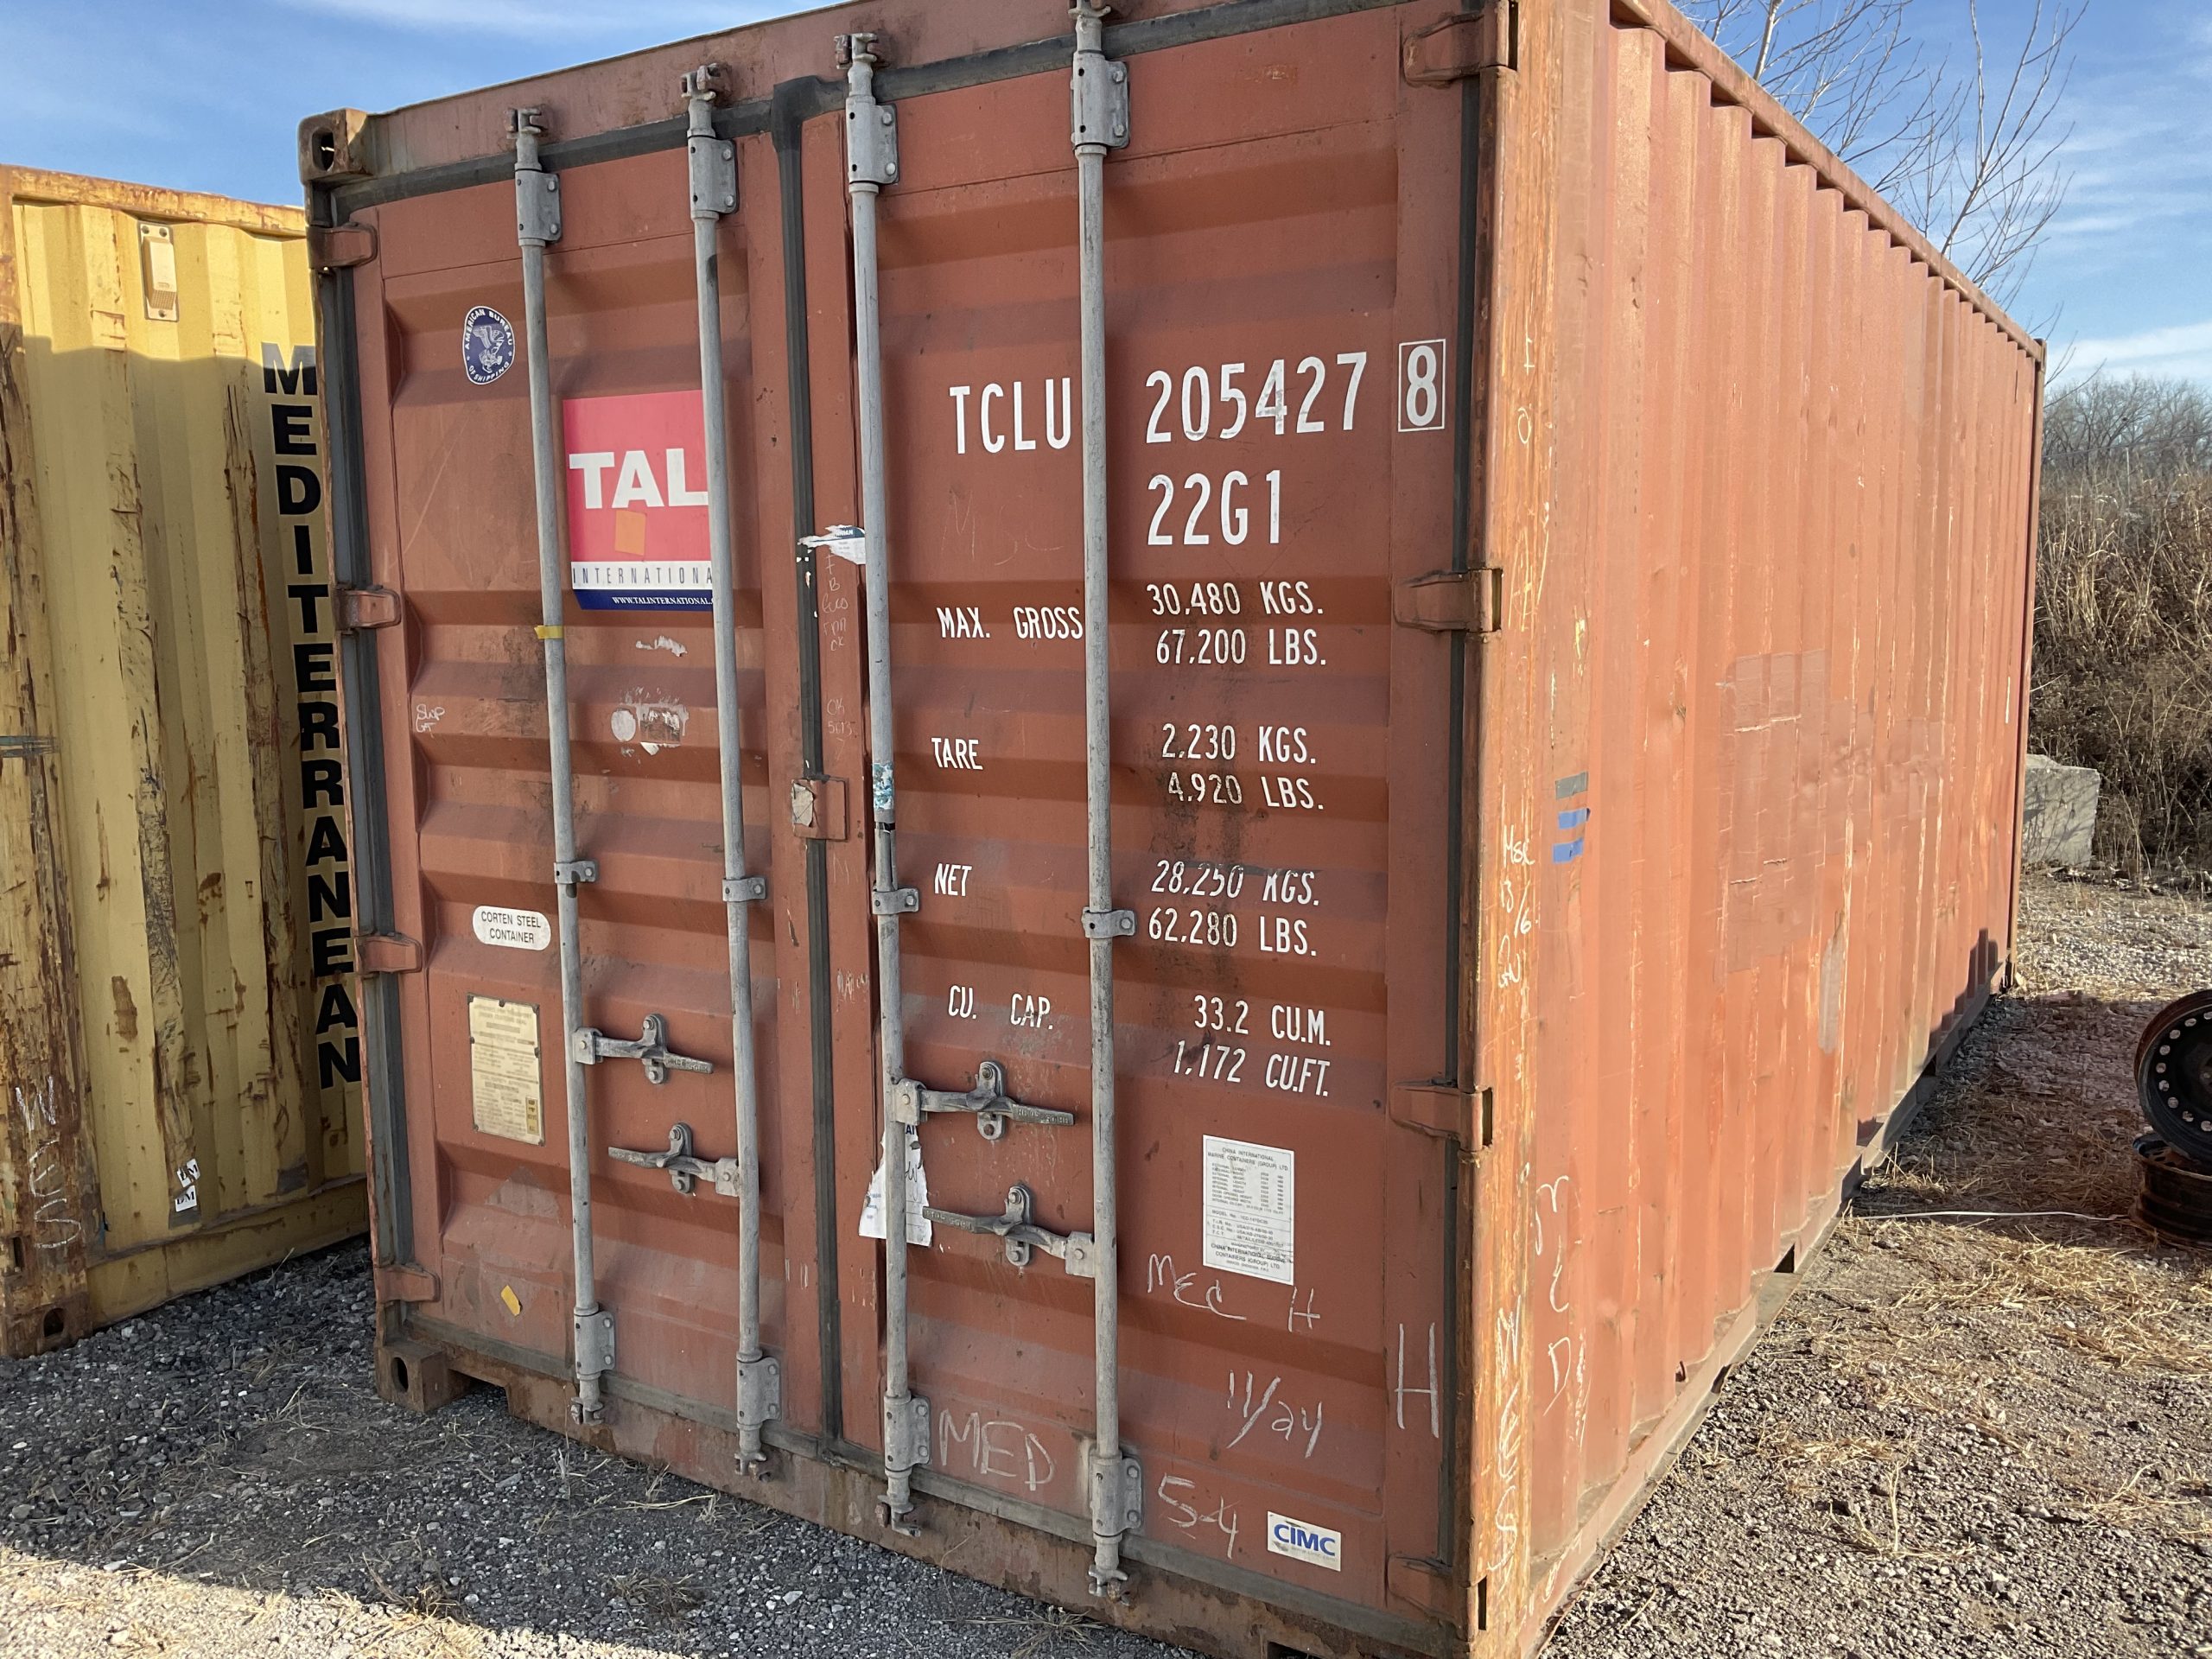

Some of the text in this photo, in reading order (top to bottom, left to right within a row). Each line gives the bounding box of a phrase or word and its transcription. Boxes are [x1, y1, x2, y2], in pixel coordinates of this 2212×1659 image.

[465, 308, 513, 350] AMERICAN BUREAU
[469, 361, 510, 382] OF SHIPPING
[949, 345, 1439, 454] TCLU 205427 8
[569, 448, 709, 510] TAL
[1147, 469, 1281, 545] 22G1
[573, 567, 713, 584] INTERNATIONA
[611, 596, 714, 605] WWW.TALINTERNATIONAL.
[1259, 581, 1325, 615] KGS.
[936, 605, 1084, 640] MAX. GROSS
[1268, 628, 1326, 665] LBS.
[262, 342, 362, 1090] MEDITERRANEAN
[931, 737, 984, 771] TARE
[1258, 726, 1316, 764] KGS.
[1260, 776, 1325, 810] LBS.
[933, 862, 973, 898] NET
[1262, 868, 1319, 906] KGS.
[480, 911, 542, 928] CORTEN STEEL
[489, 927, 535, 944] CONTAINER
[1259, 915, 1317, 957] LBS.
[947, 985, 1053, 1031] CU. CAP.
[1193, 995, 1332, 1046] 33.2 CU.M.
[1265, 1052, 1331, 1097] CU.FT.
[1227, 1154, 1255, 1165] CONTAINERS
[1237, 1150, 1274, 1161] INTERNATIONAL
[1211, 1243, 1226, 1251] CHINA
[1227, 1246, 1265, 1259] INTERNATIONAL
[1215, 1250, 1246, 1262] CONTAINERS
[938, 1408, 1055, 1491] MED
[1274, 1523, 1336, 1557] CIMC
